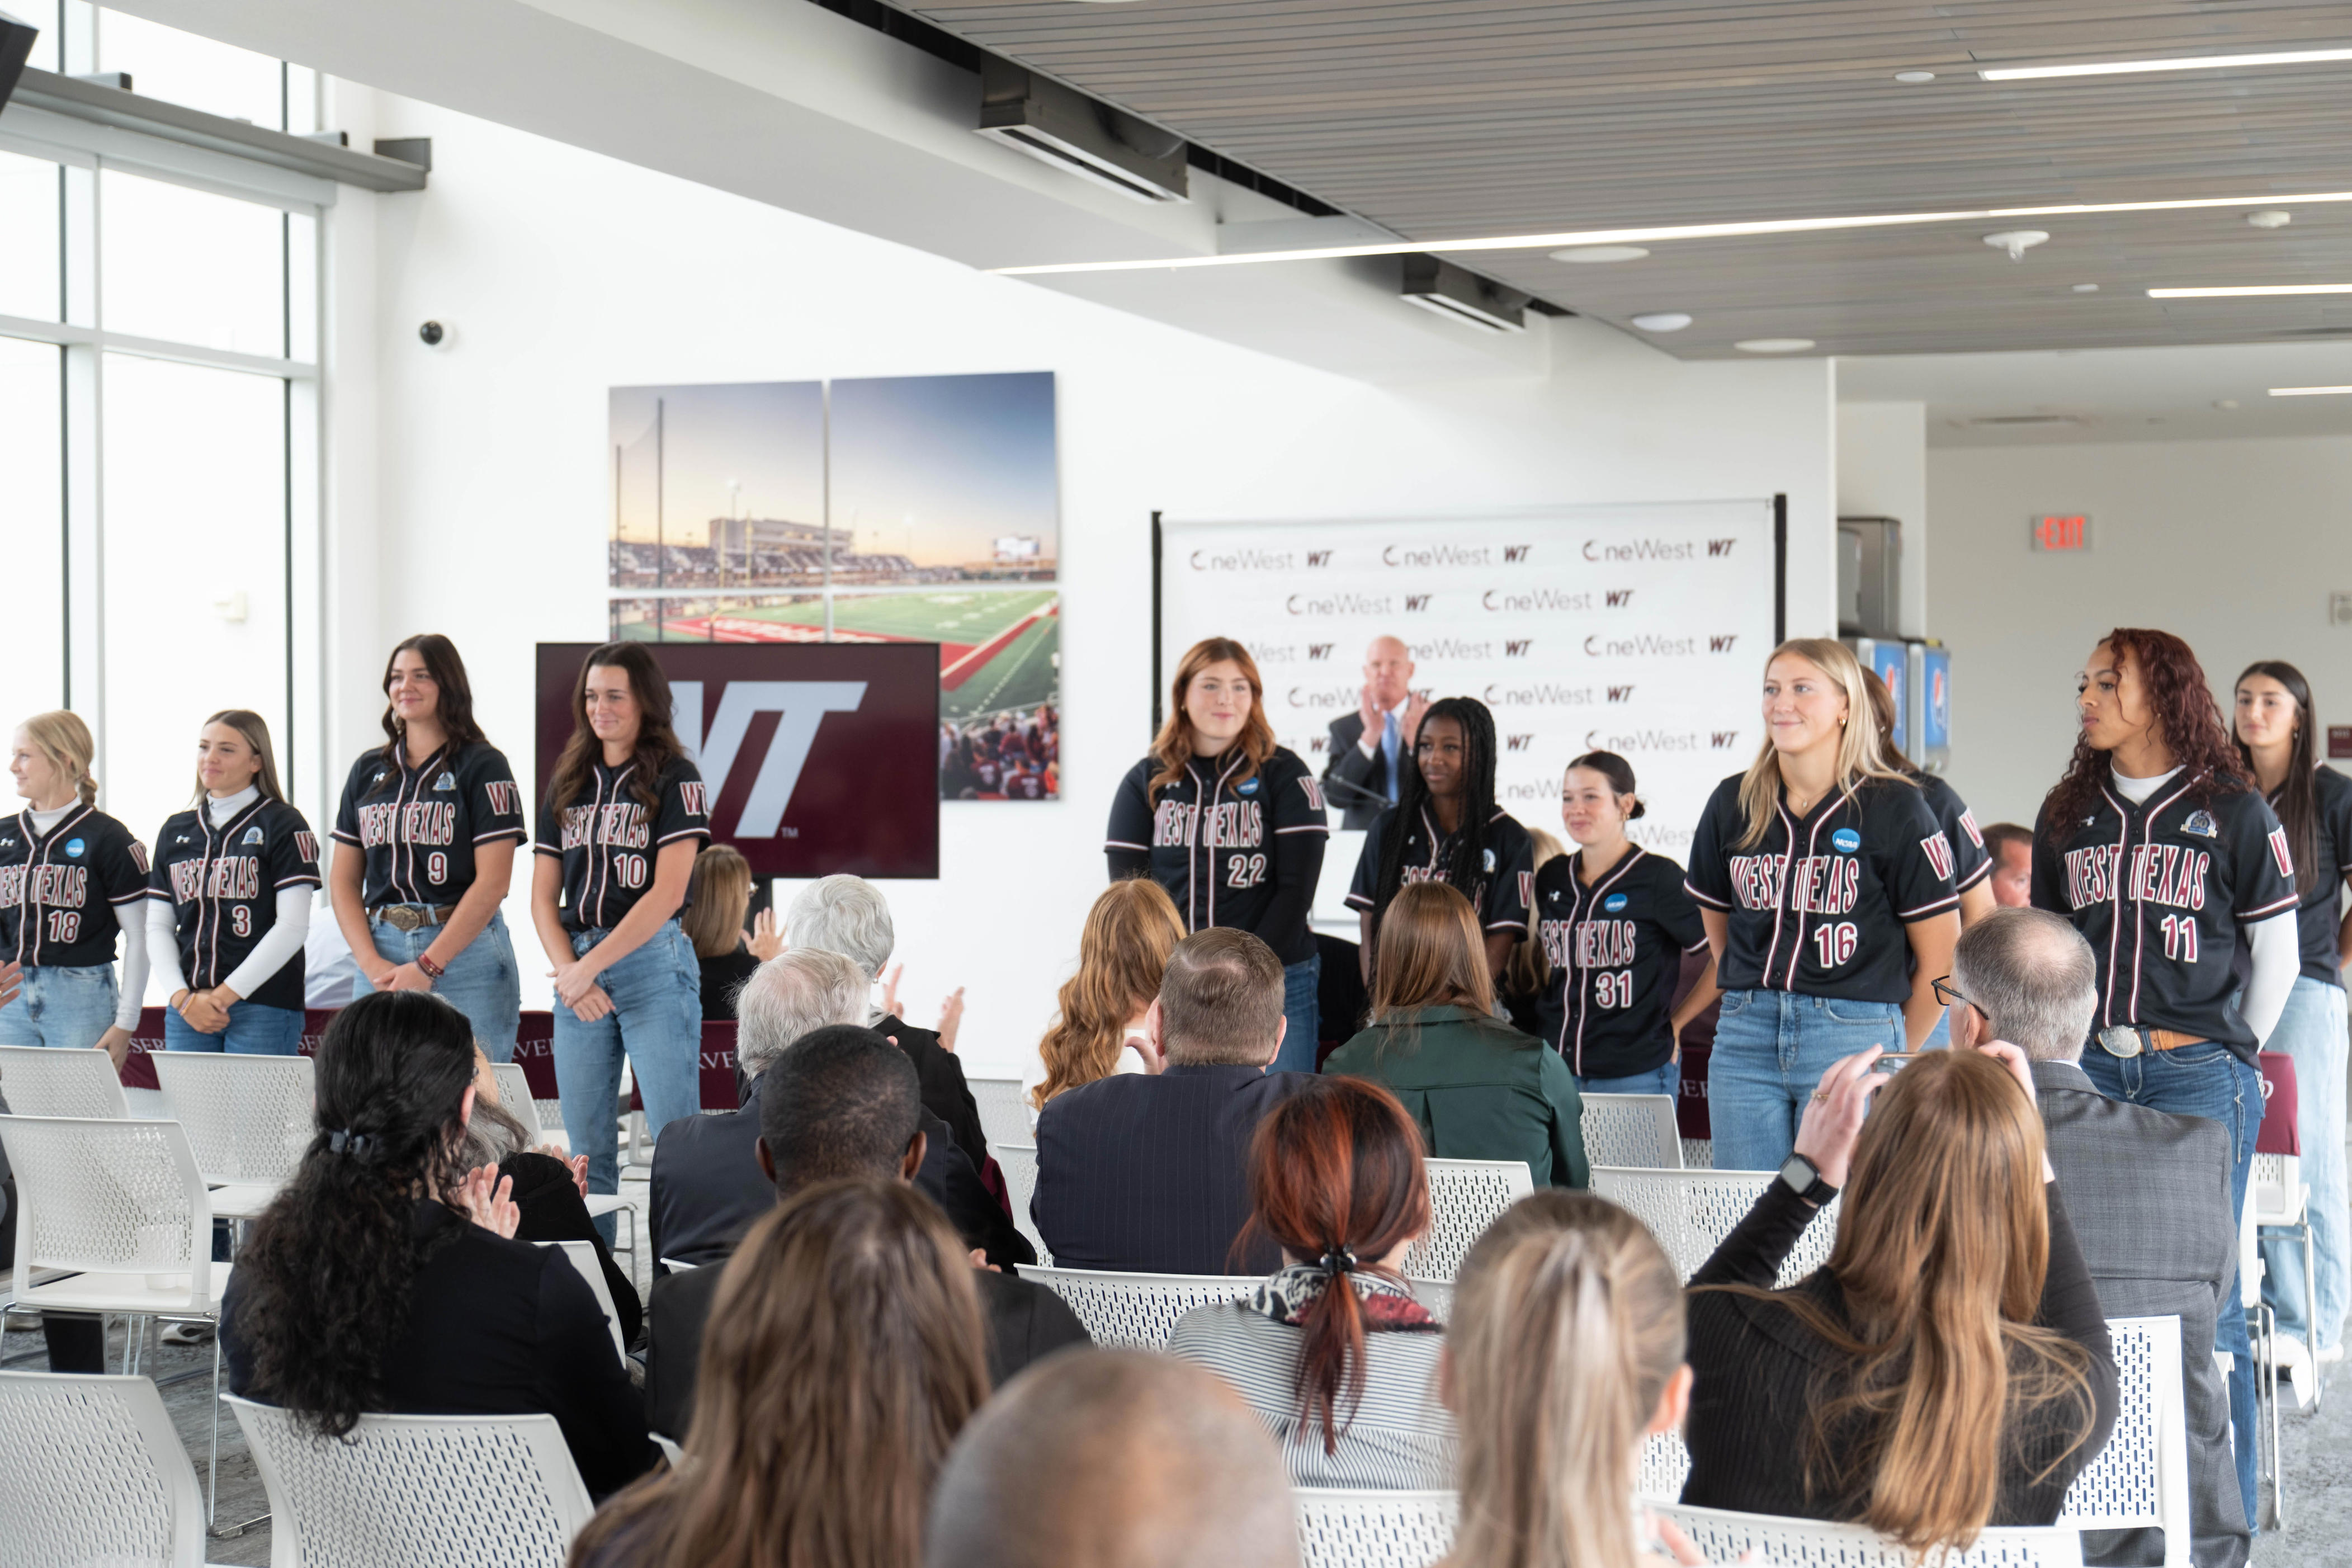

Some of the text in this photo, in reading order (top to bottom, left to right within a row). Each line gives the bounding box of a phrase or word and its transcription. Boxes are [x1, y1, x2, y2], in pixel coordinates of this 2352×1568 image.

[1708, 538, 1737, 556] WT
[2044, 516, 2085, 549] EXIT
[1307, 550, 1335, 568] WT
[1504, 545, 1532, 562] WT
[1405, 593, 1433, 612] WT
[1606, 589, 1634, 607] WT
[1309, 643, 1335, 660] WT
[1505, 639, 1533, 657] WT
[1709, 635, 1737, 653] WT
[1607, 686, 1635, 702] WT
[1507, 734, 1533, 752] WT
[1711, 731, 1739, 749] WT
[402, 801, 455, 846] TEXAS
[782, 828, 799, 838] TM
[1203, 800, 1263, 848] TEXAS
[1835, 838, 1858, 849] NCAA
[207, 856, 259, 899] TEXAS
[428, 851, 448, 886] 9
[614, 853, 647, 889] 10
[1227, 853, 1268, 889] 22
[1730, 853, 1787, 910] WEST
[2065, 843, 2211, 911] WEST TEXAS
[0, 863, 88, 909] EST TEXAS
[48, 909, 82, 944] 18
[232, 904, 252, 938] 3
[1575, 919, 1636, 968] TEXAS
[1814, 922, 1858, 969] 16
[2161, 913, 2198, 964] 11
[1595, 970, 1632, 1009] 31
